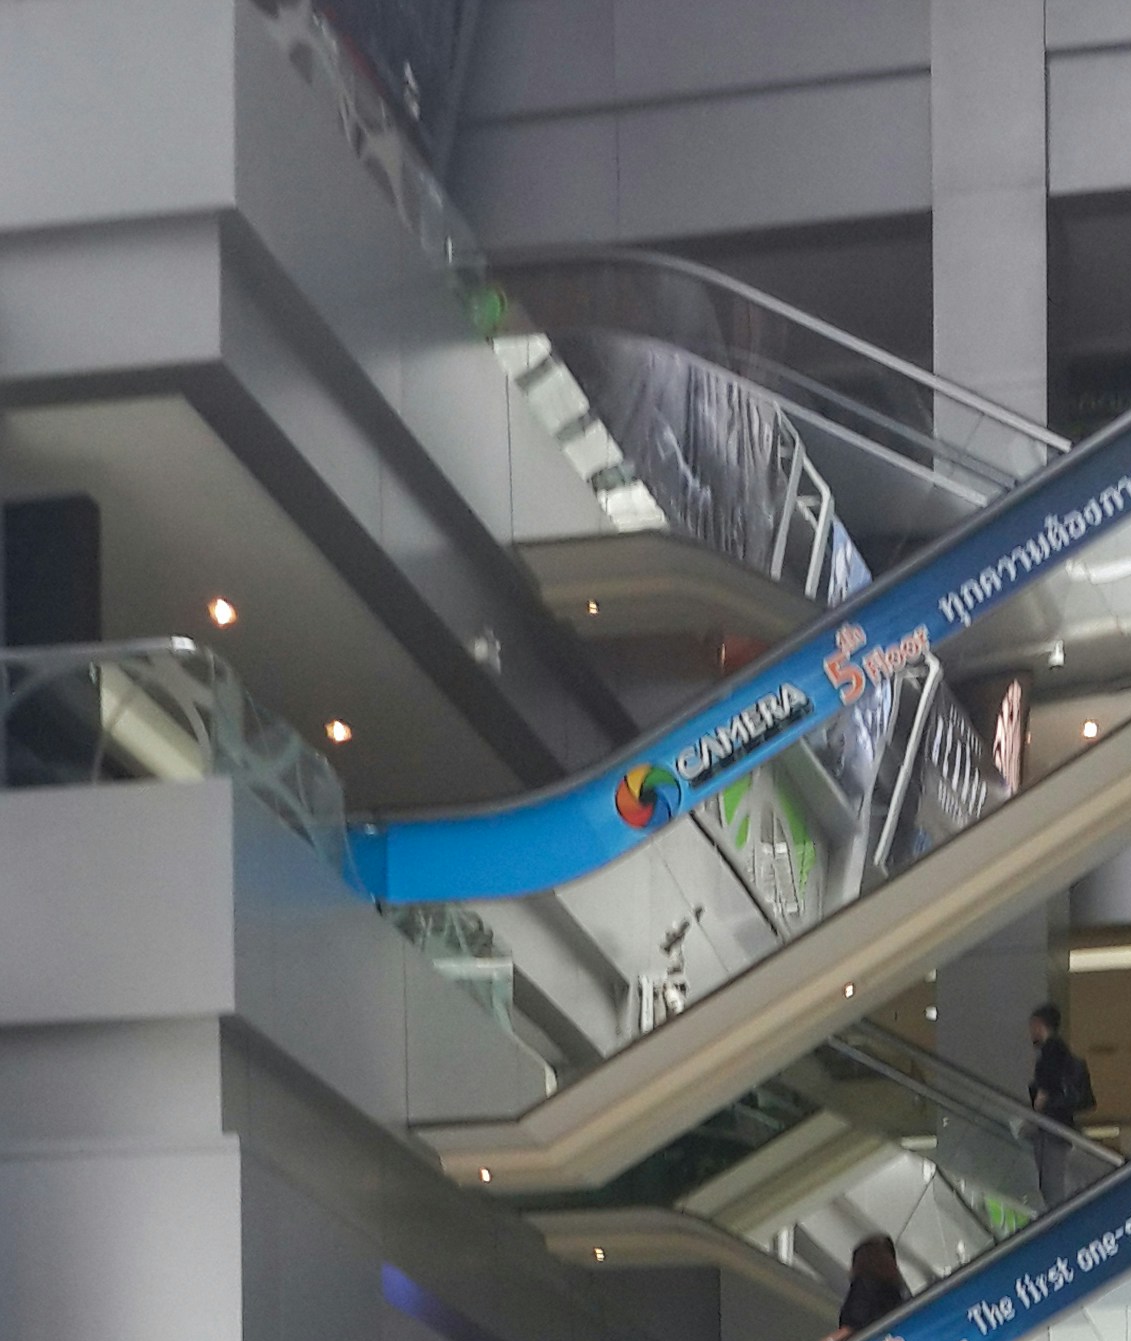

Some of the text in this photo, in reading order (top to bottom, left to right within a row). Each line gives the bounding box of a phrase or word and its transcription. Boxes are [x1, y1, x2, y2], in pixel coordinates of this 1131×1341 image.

[862, 624, 932, 685] Floor
[676, 682, 808, 780] CAMERA
[967, 1296, 1015, 1336] The
[1015, 1256, 1074, 1310] first
